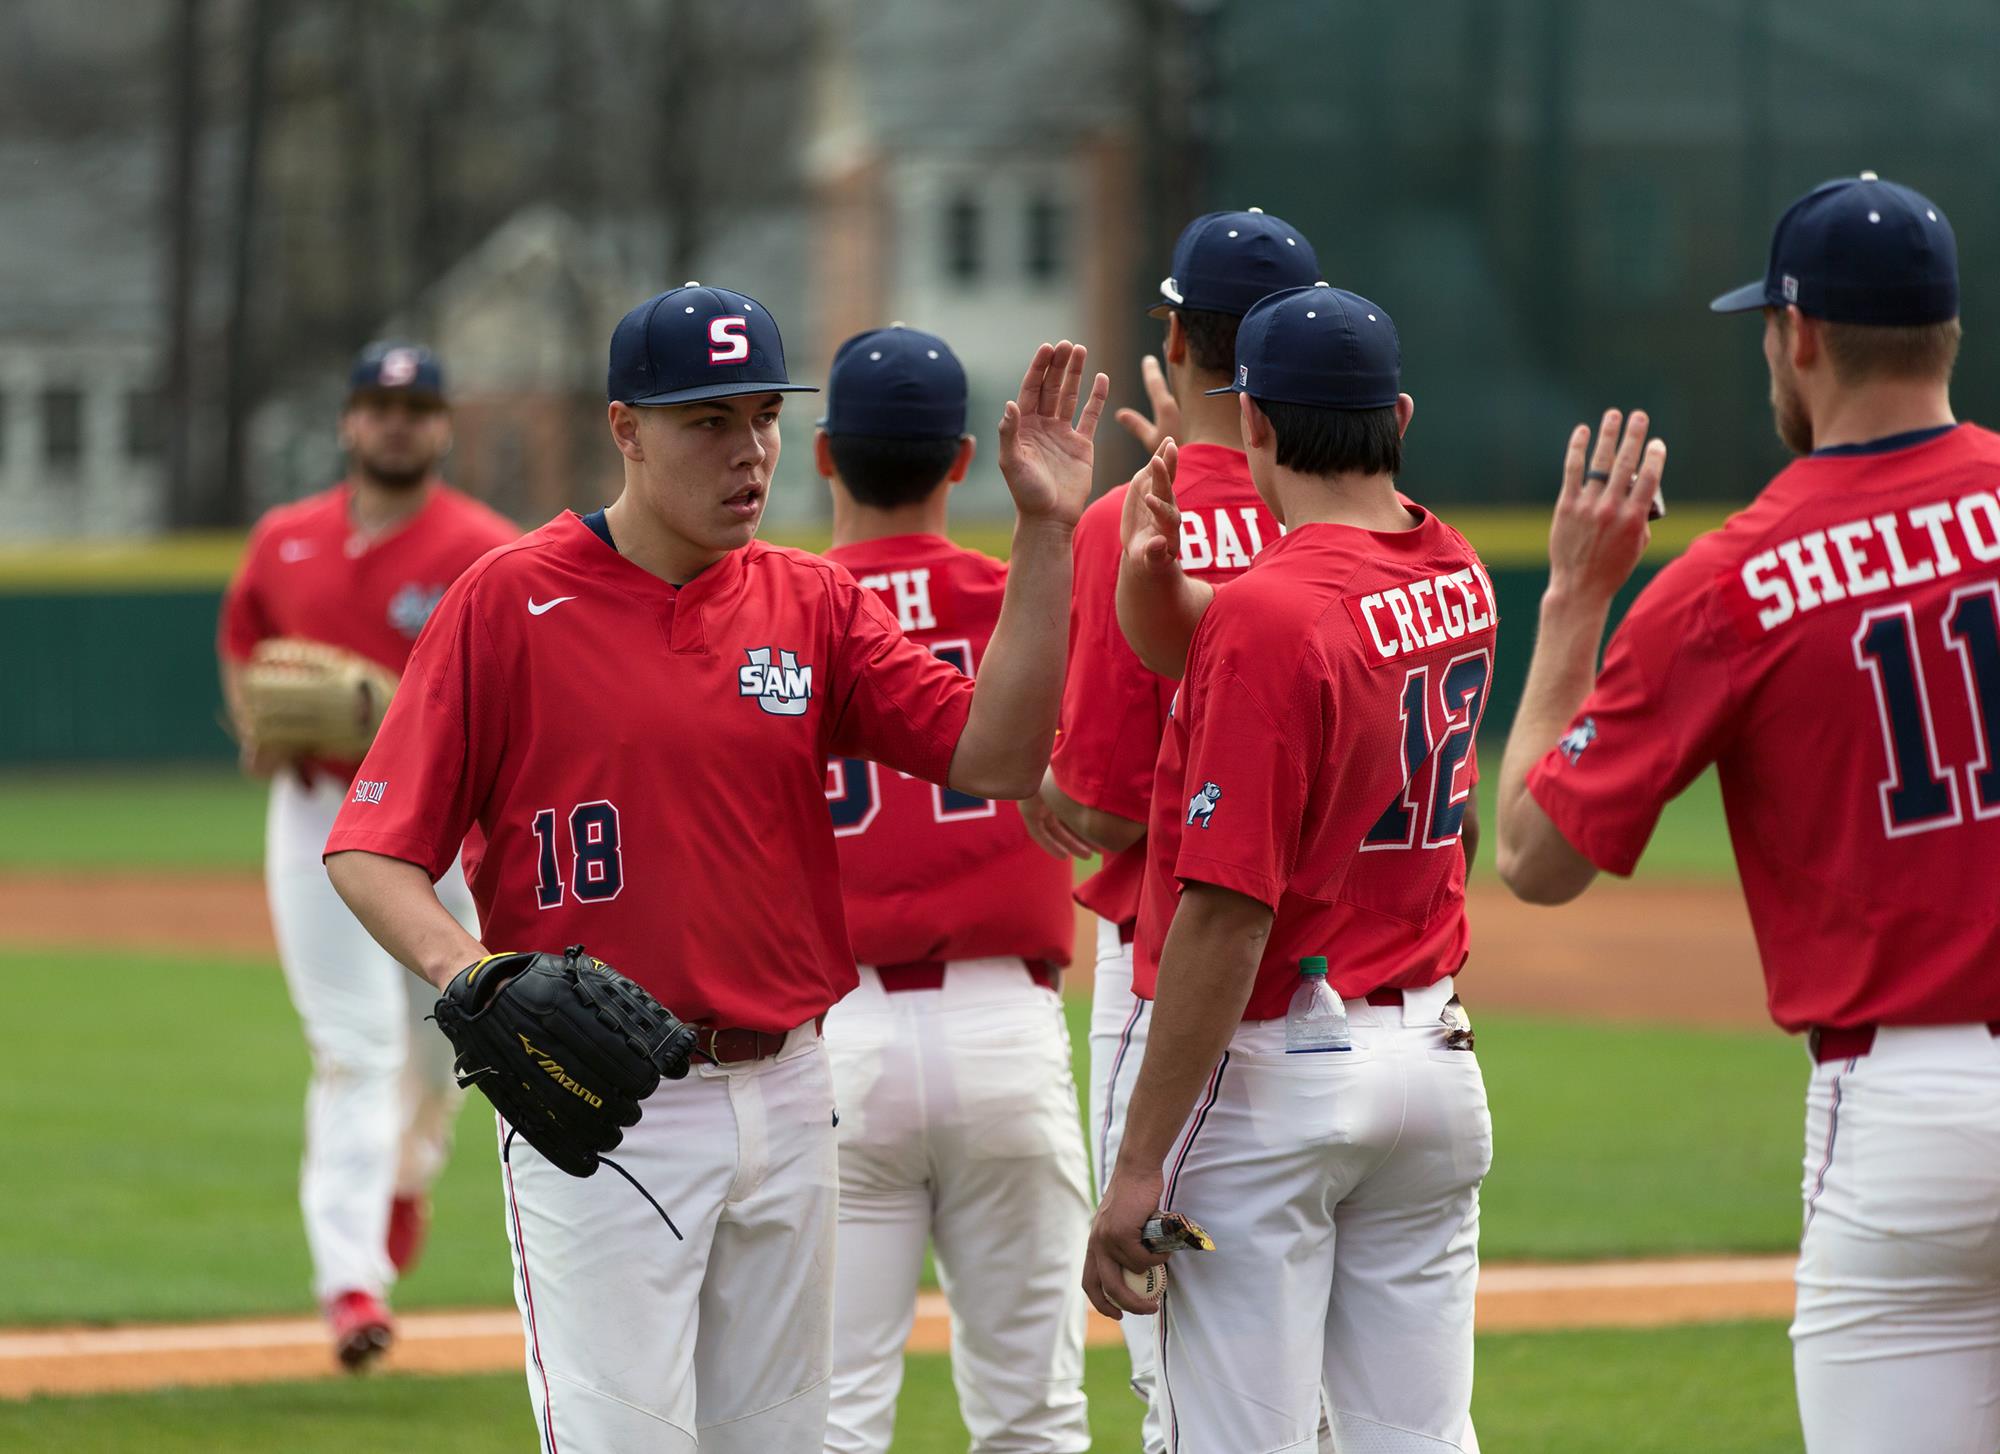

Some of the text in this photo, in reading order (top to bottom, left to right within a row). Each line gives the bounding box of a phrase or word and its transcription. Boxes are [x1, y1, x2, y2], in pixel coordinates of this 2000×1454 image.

[708, 315, 750, 365] S
[1179, 507, 1287, 570] BAL
[1741, 488, 2000, 631] SHELTO
[738, 664, 813, 700] SAM
[1852, 580, 2000, 839] 11
[1359, 648, 1490, 852] 12
[531, 799, 624, 910] 18
